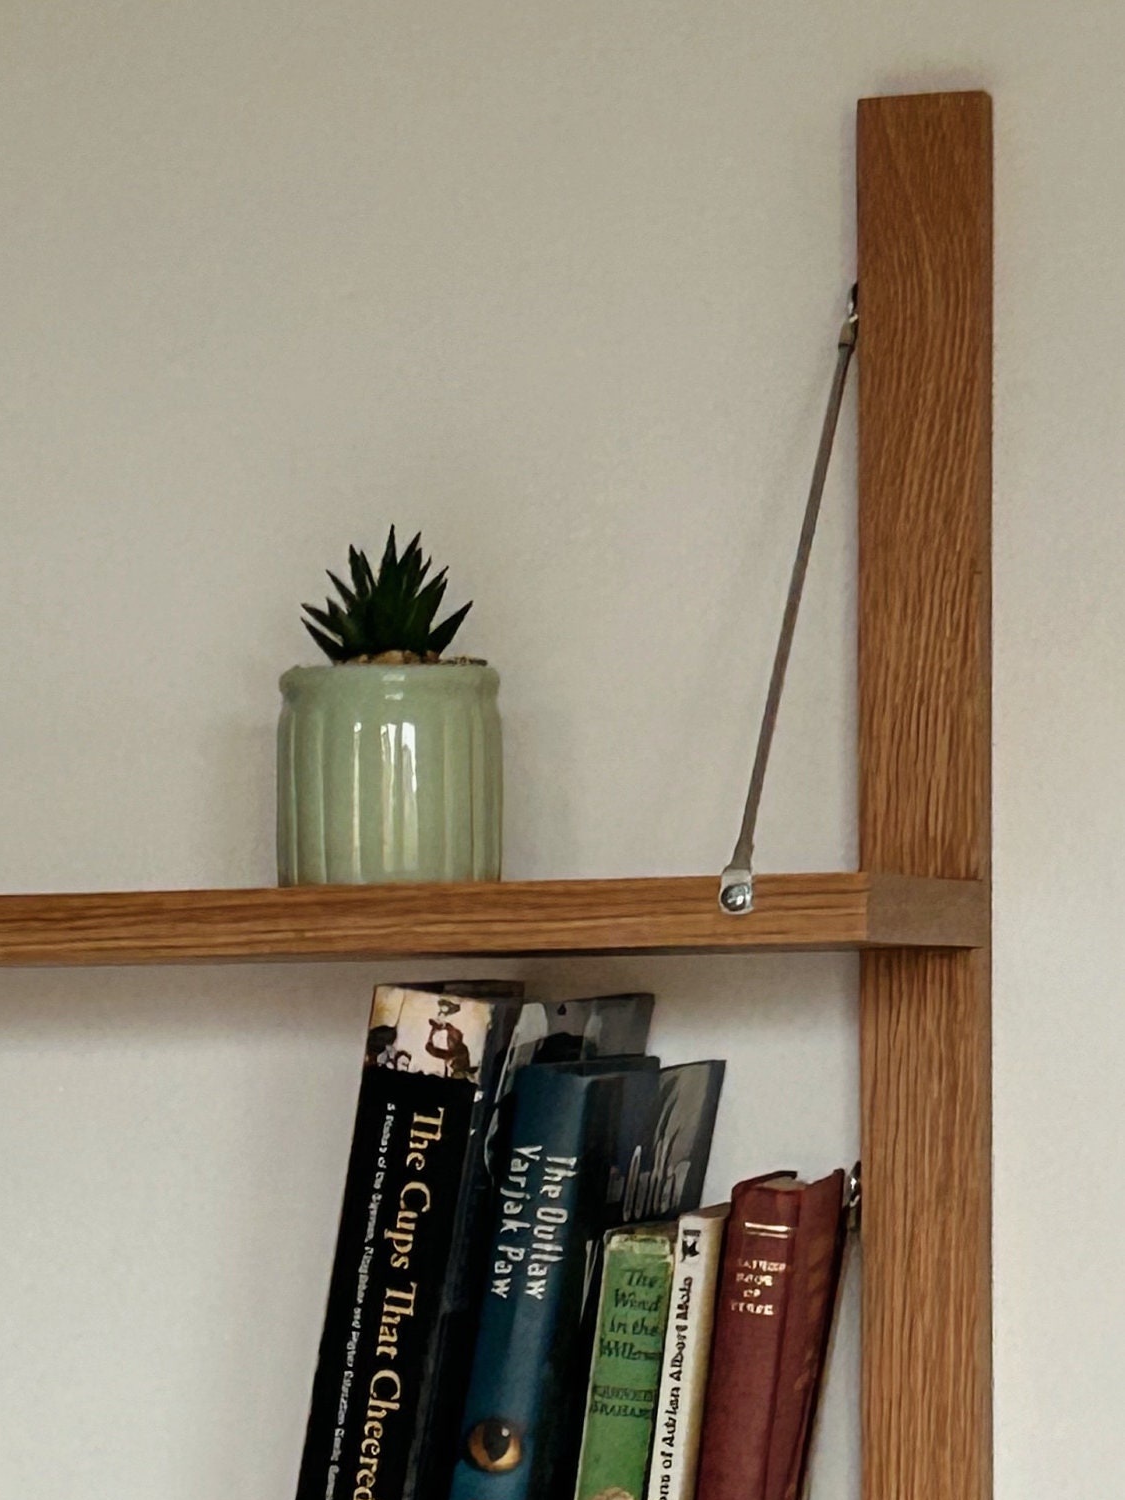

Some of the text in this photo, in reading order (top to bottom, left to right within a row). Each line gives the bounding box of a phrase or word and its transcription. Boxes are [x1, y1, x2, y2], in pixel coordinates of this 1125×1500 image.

[406, 1107, 445, 1170] The
[384, 1182, 431, 1269] Cups
[491, 1145, 543, 1299] Varjak Paw
[525, 1156, 577, 1300] The Outlaw
[622, 1267, 659, 1289] The
[376, 1282, 417, 1360] That
[660, 1450, 673, 1469] of
